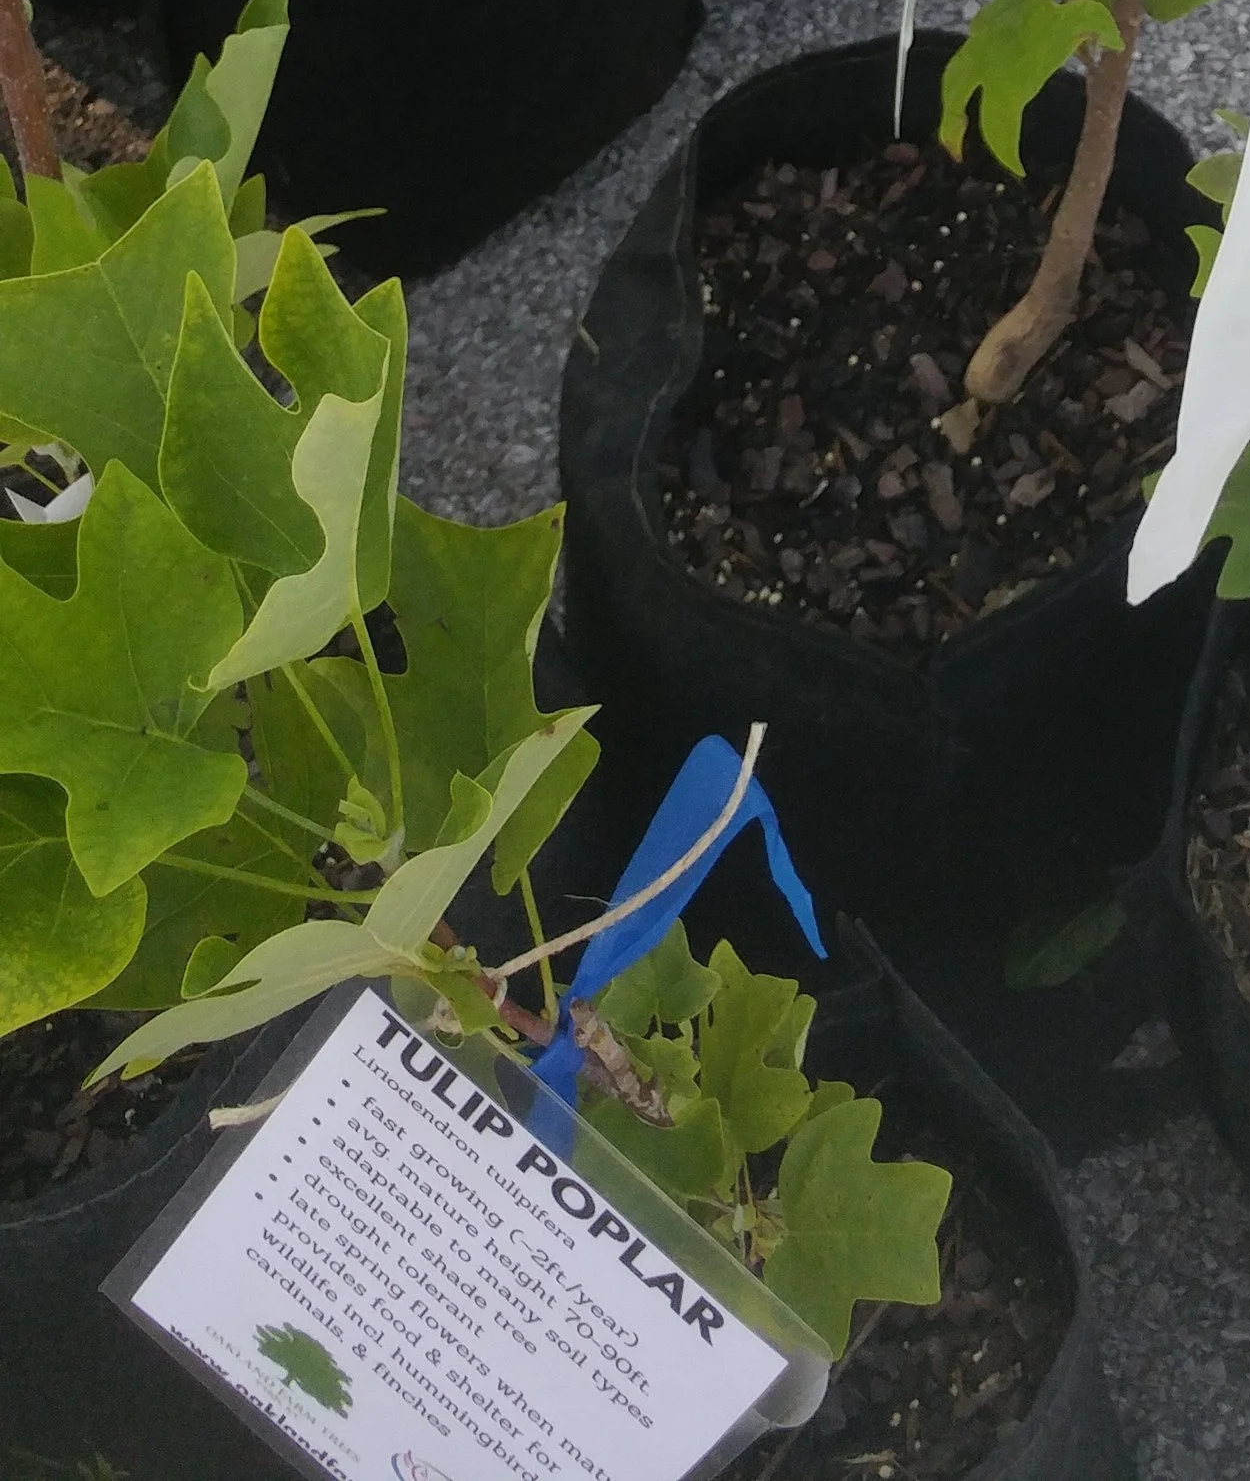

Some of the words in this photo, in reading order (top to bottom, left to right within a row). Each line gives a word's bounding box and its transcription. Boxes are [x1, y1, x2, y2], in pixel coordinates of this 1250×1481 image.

[353, 1045, 479, 1164] Liriodendron
[486, 1165, 575, 1250] tulipifera
[362, 1097, 407, 1140] fast
[409, 1143, 504, 1229] growing
[376, 1009, 514, 1138] TULIP
[515, 1143, 724, 1346] POPLAR
[246, 1248, 343, 1343] cardinals,
[352, 1343, 367, 1361] &
[372, 1362, 451, 1436] finches
[263, 1228, 337, 1302] wildlife
[343, 1304, 384, 1348] incl.
[272, 1210, 367, 1296] provides
[370, 1298, 422, 1347] food
[425, 1348, 441, 1367] &
[445, 1370, 523, 1438] shelter
[526, 1441, 561, 1473] for
[290, 1188, 331, 1231] late
[335, 1234, 406, 1300] spring
[409, 1300, 490, 1376] flowers
[497, 1377, 554, 1436] when
[304, 1174, 391, 1254] drought
[397, 1256, 484, 1338] tolerant
[319, 1155, 416, 1246] excellent
[421, 1248, 487, 1309] shade
[494, 1311, 537, 1354] tree
[333, 1136, 442, 1237] adaptable
[449, 1239, 471, 1262] to
[476, 1266, 542, 1323] many
[545, 1329, 588, 1368] soil
[592, 1369, 653, 1429] types
[347, 1118, 390, 1158] avg.
[398, 1162, 478, 1237] mature
[483, 1237, 557, 1309] height
[565, 1307, 649, 1393] 70-90ft.
